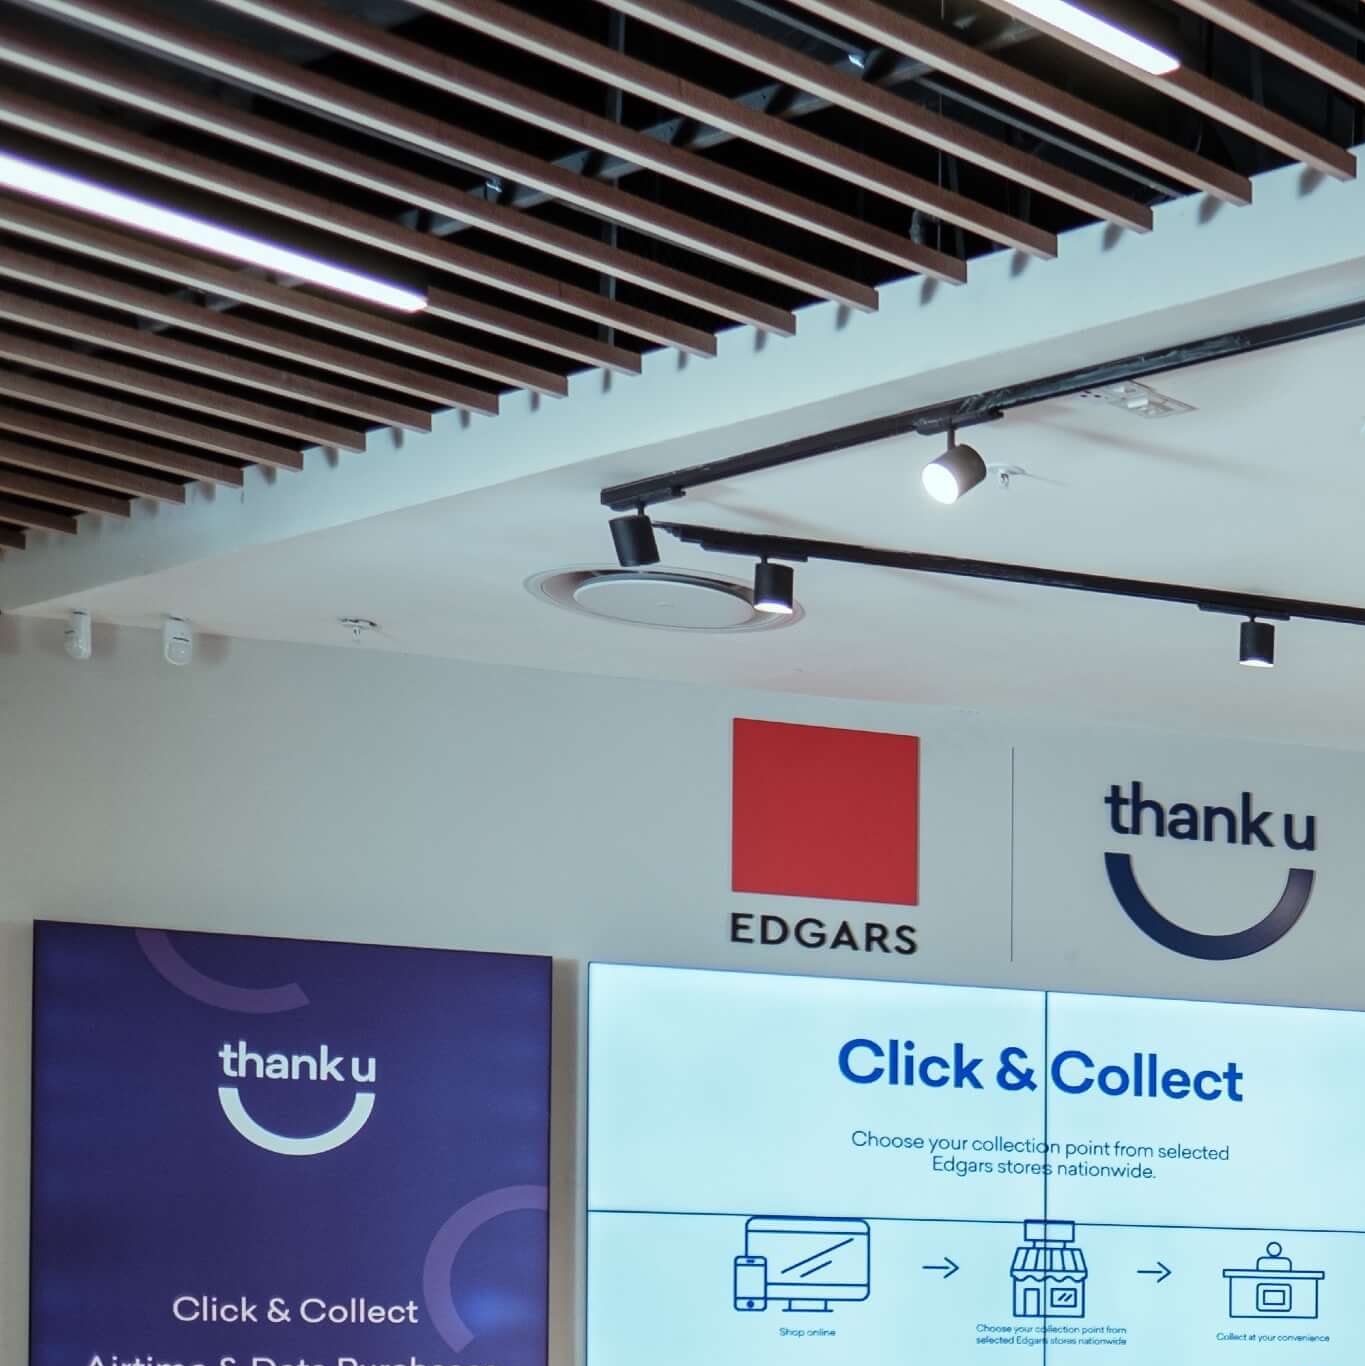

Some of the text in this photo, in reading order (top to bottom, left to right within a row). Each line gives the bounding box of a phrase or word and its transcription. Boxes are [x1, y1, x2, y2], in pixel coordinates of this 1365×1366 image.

[1105, 780, 1316, 853] thank u
[730, 911, 919, 956] EDGARS
[219, 1041, 377, 1083] thank u
[838, 1038, 1244, 1102] Click & Collect
[851, 1130, 1230, 1161] Choose your collection point from selected
[932, 1156, 1156, 1179] Edgars stores nationwide.
[172, 1296, 419, 1325] Click & Collect
[779, 1327, 836, 1338] Shop online
[976, 1323, 1012, 1334] Choose
[1014, 1326, 1033, 1336] your
[1082, 1325, 1104, 1337] point
[1106, 1325, 1127, 1335] from
[976, 1335, 1014, 1345] selected
[1050, 1336, 1076, 1346] stores
[1078, 1336, 1127, 1346] nationwide
[1216, 1332, 1247, 1342] Collect
[1258, 1334, 1276, 1343] your
[1277, 1334, 1330, 1343] convenience
